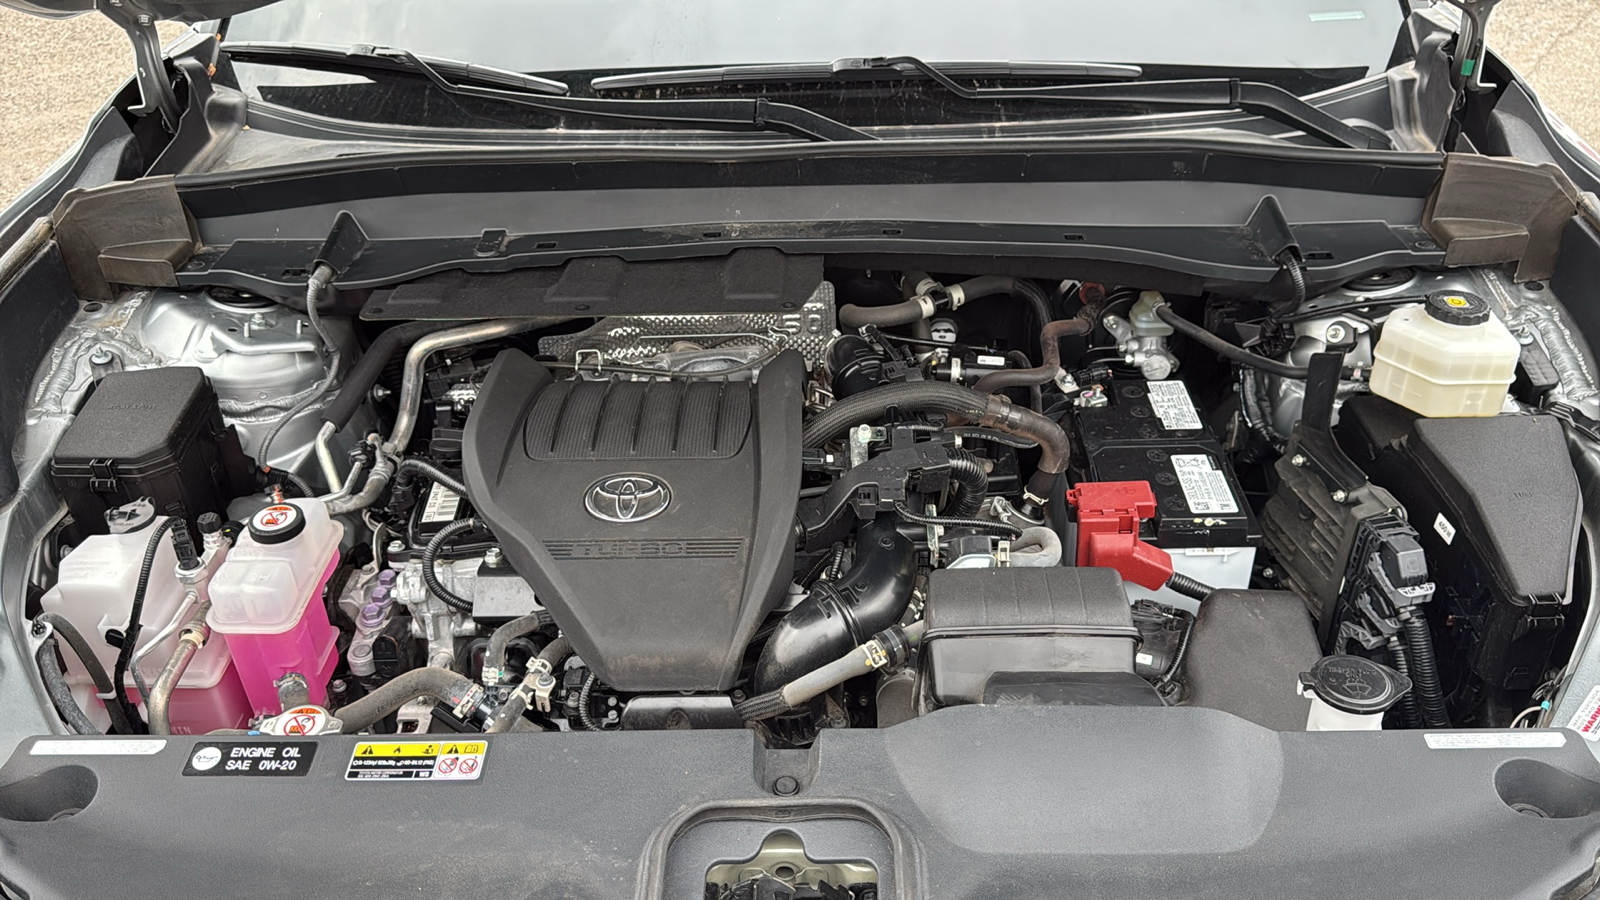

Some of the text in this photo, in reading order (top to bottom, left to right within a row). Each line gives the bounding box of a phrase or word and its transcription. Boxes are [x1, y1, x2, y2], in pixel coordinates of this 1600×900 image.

[573, 542, 684, 557] TURBO
[1581, 705, 1600, 732] WARN
[230, 747, 302, 758] ENGINE OIL
[225, 760, 298, 771] SAE 0W-20
